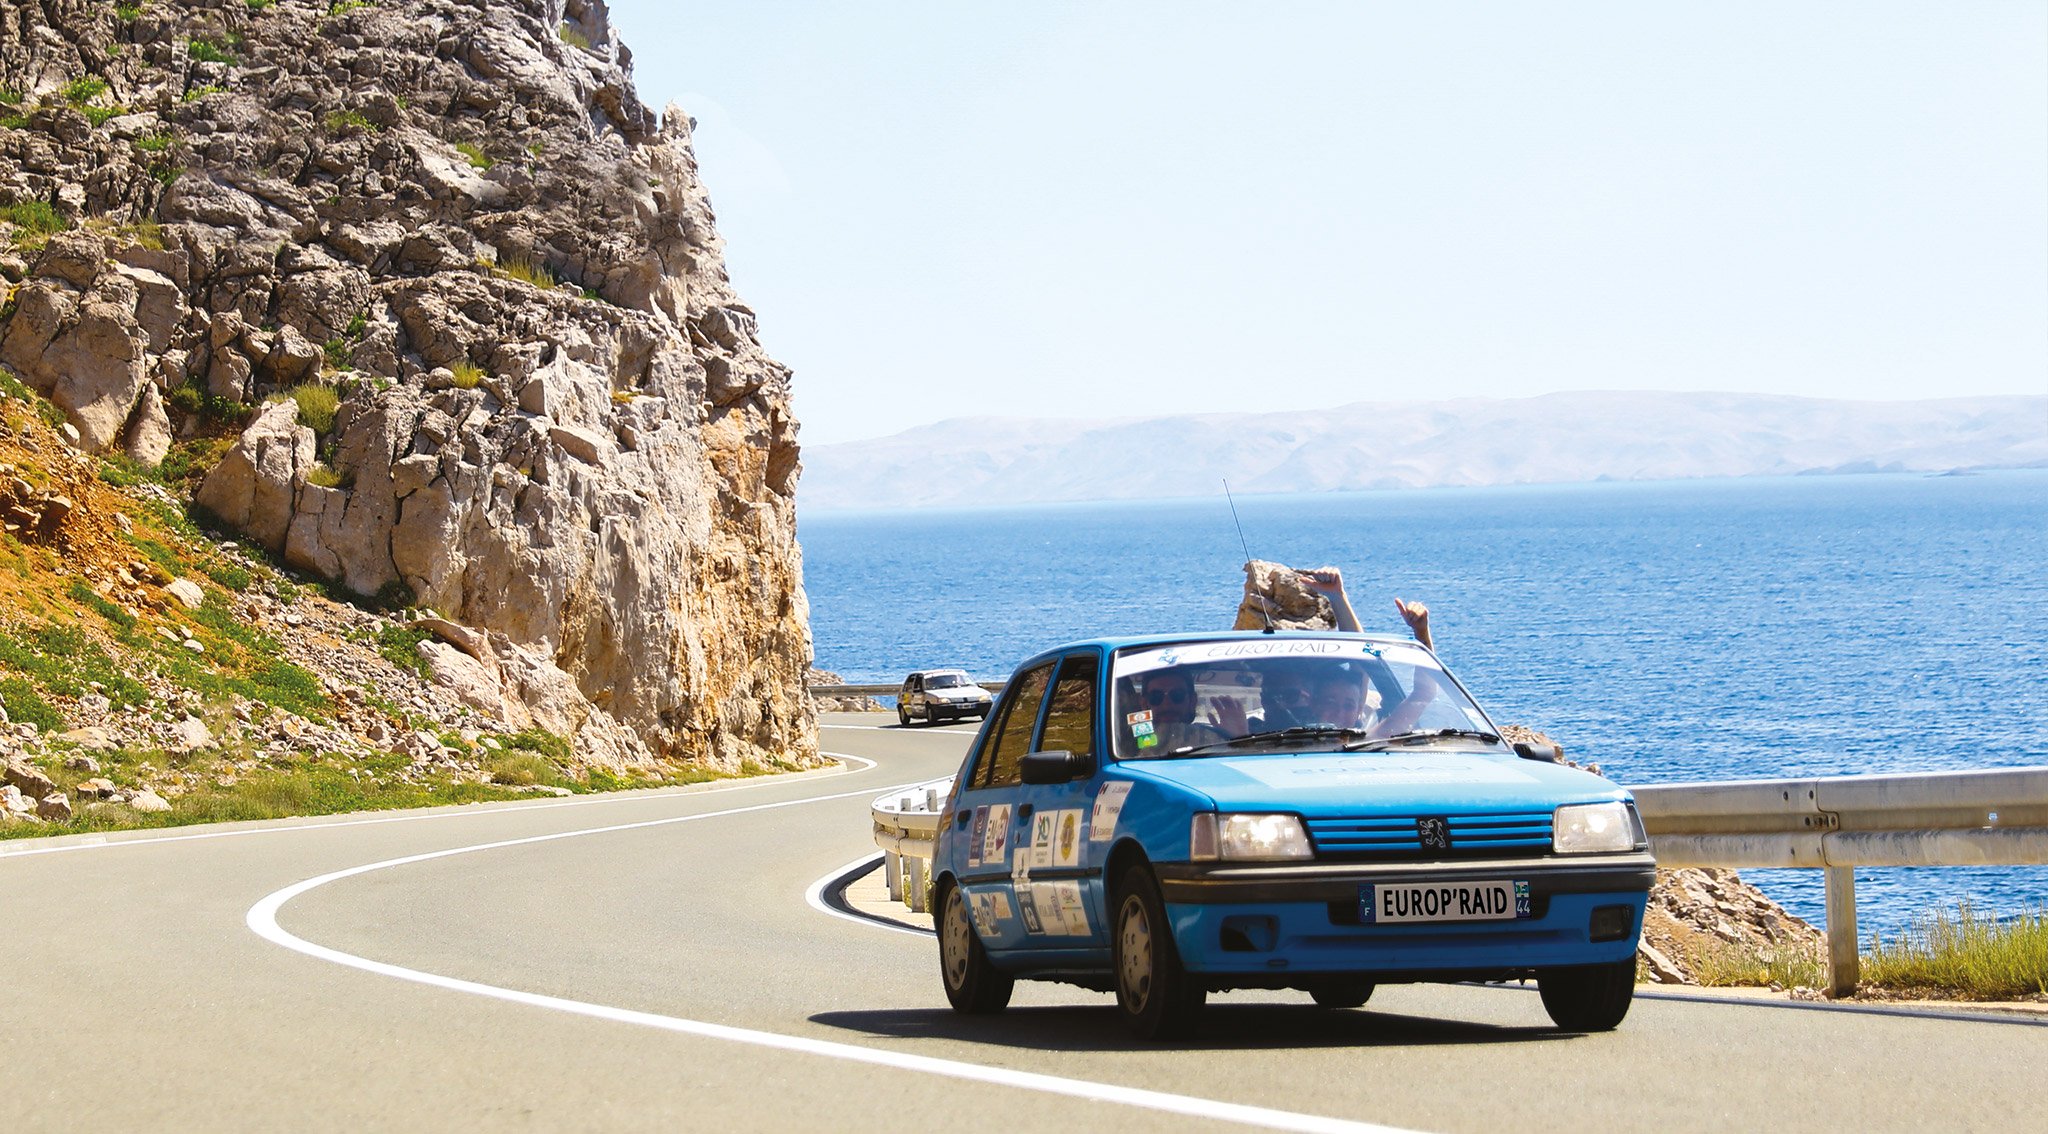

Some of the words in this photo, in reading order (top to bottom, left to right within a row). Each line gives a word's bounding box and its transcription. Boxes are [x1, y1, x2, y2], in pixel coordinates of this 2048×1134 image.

[1383, 887, 1508, 917] EUROP'RAID
[1516, 900, 1531, 914] 44
[1364, 907, 1371, 916] F
